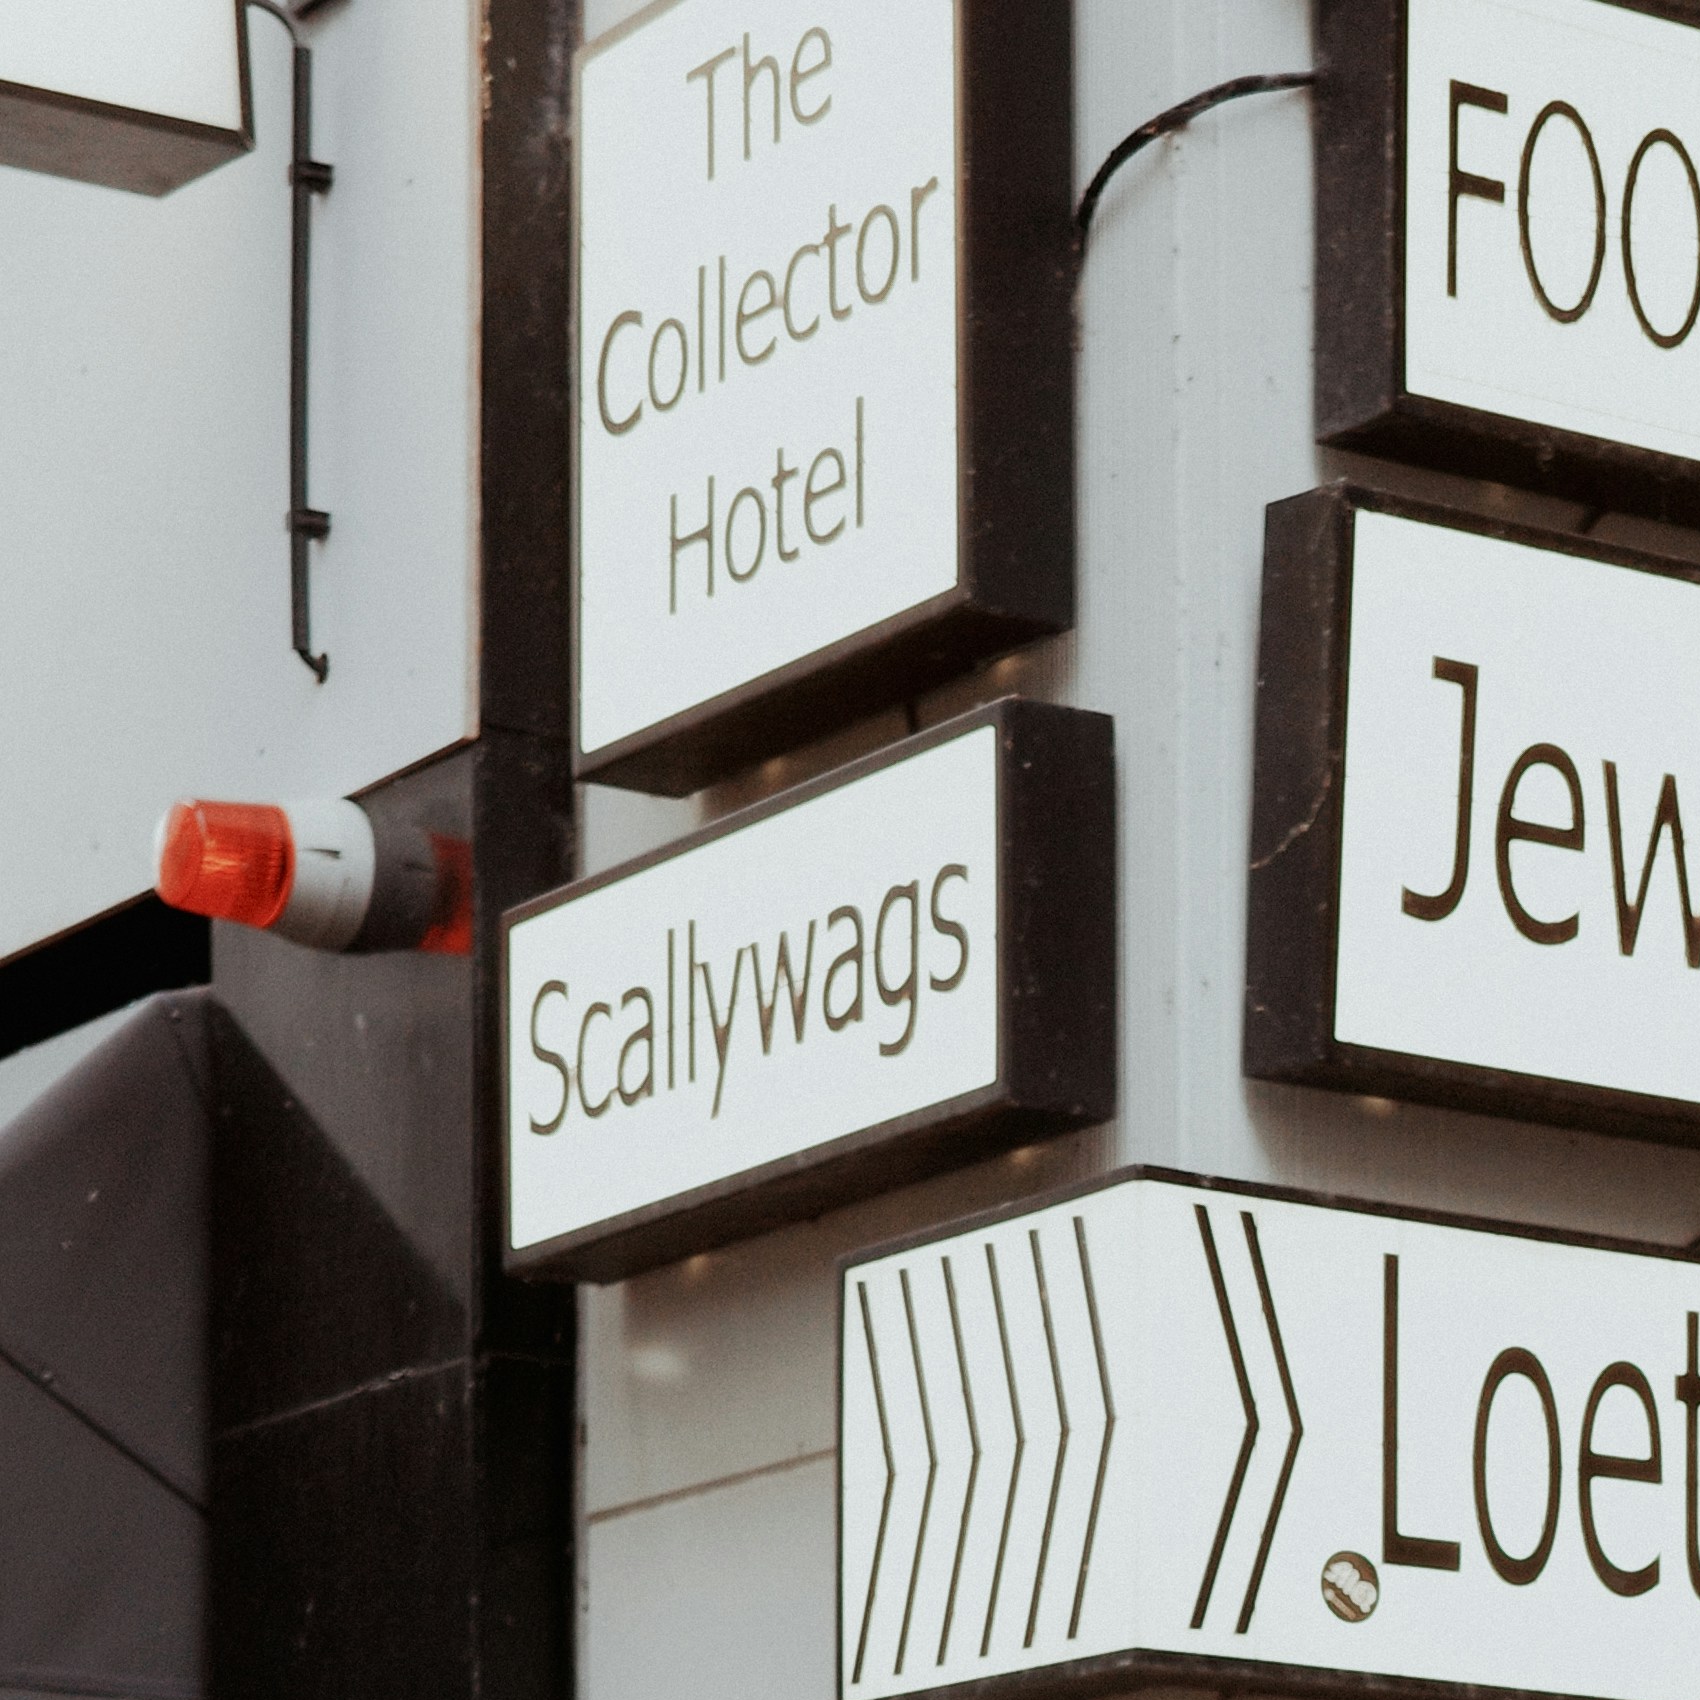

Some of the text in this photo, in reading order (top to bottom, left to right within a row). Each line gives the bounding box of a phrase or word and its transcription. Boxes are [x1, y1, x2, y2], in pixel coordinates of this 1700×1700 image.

[686, 27, 832, 180] The
[597, 176, 938, 435] Collector
[669, 396, 864, 614] Hotel
[528, 863, 970, 1135] Scallywags
